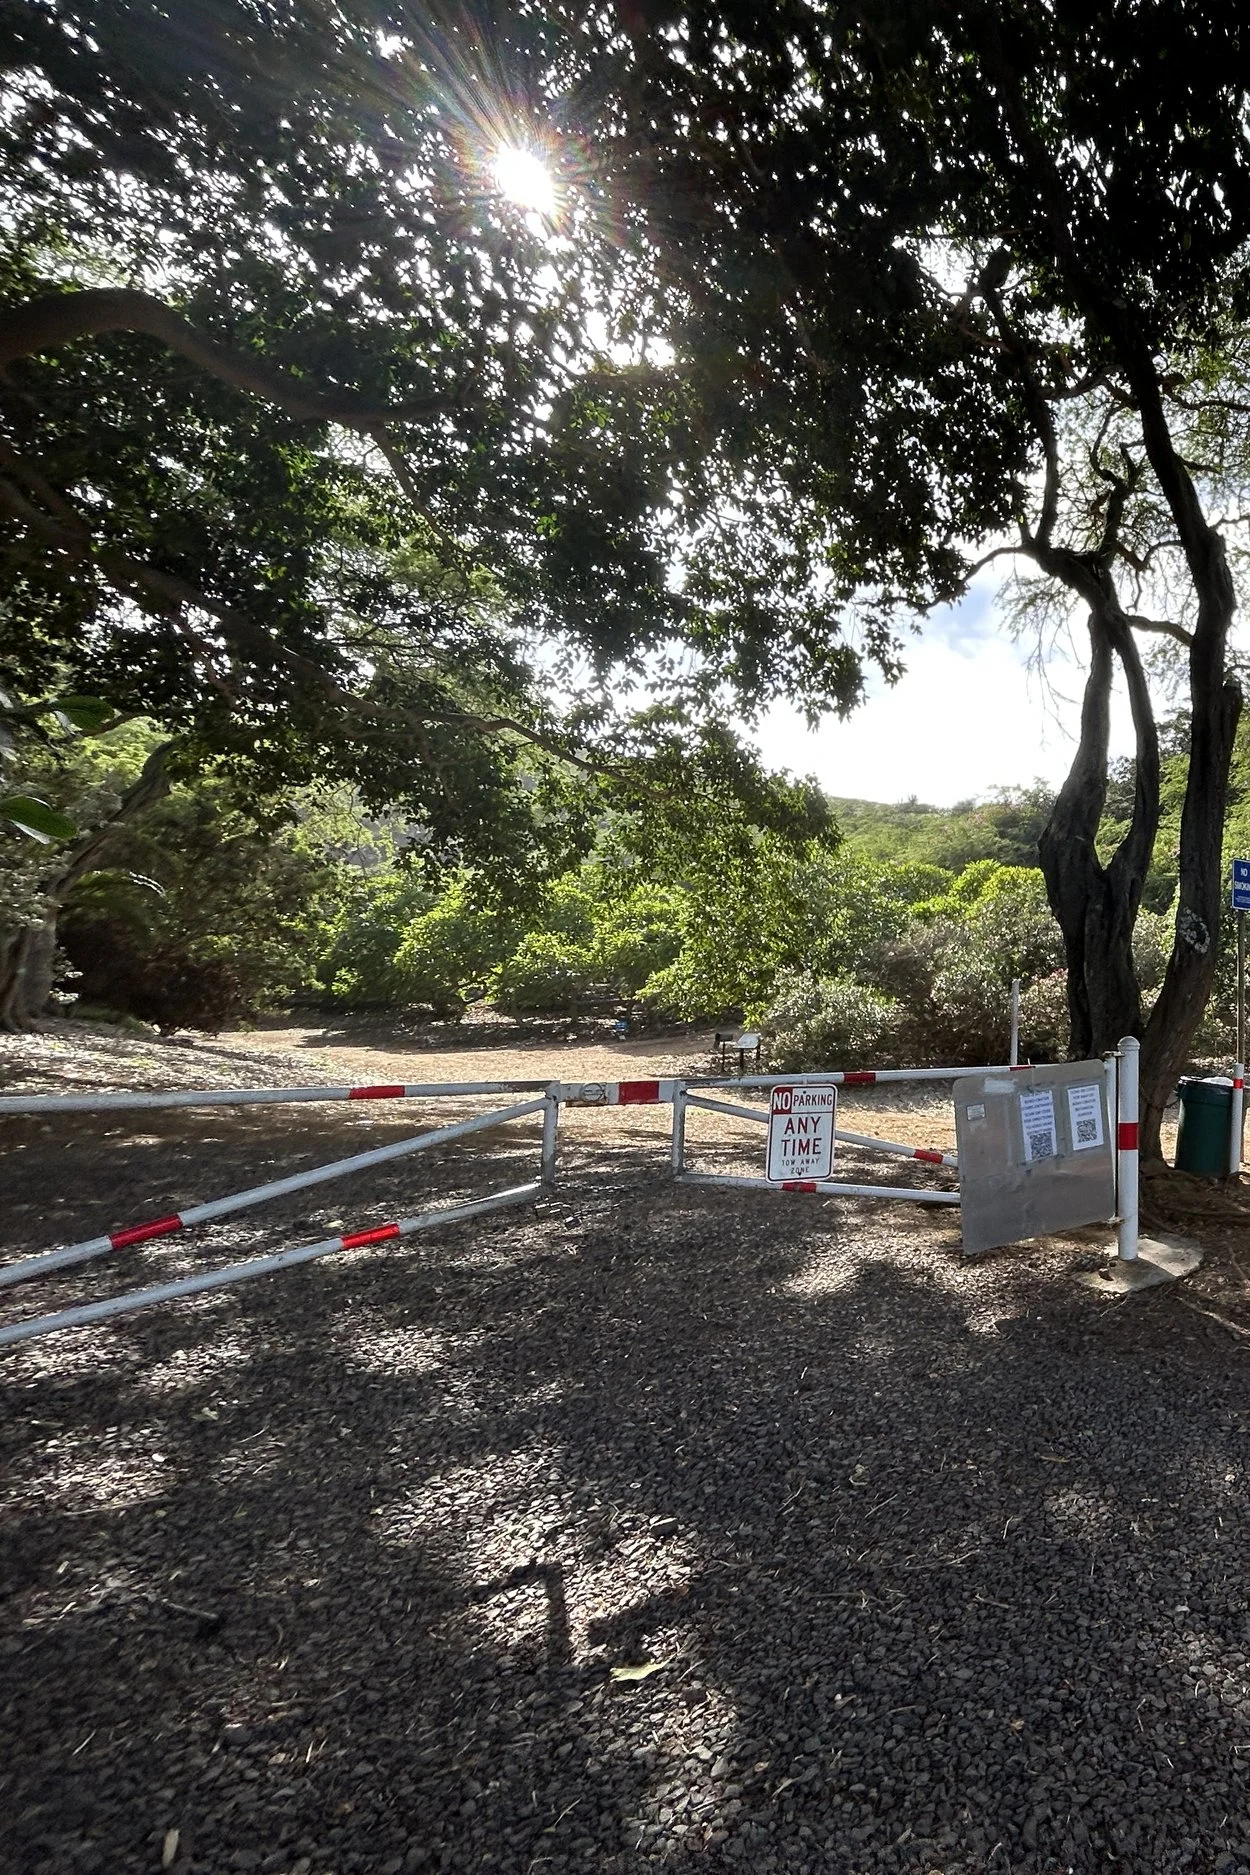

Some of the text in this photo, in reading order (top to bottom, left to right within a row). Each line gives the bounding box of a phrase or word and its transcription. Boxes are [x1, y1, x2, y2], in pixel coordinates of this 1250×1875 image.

[1240, 868, 1248, 876] NO
[773, 1092, 832, 1110] NO PARKING
[784, 1116, 821, 1134] ANY
[781, 1138, 822, 1156] TIME
